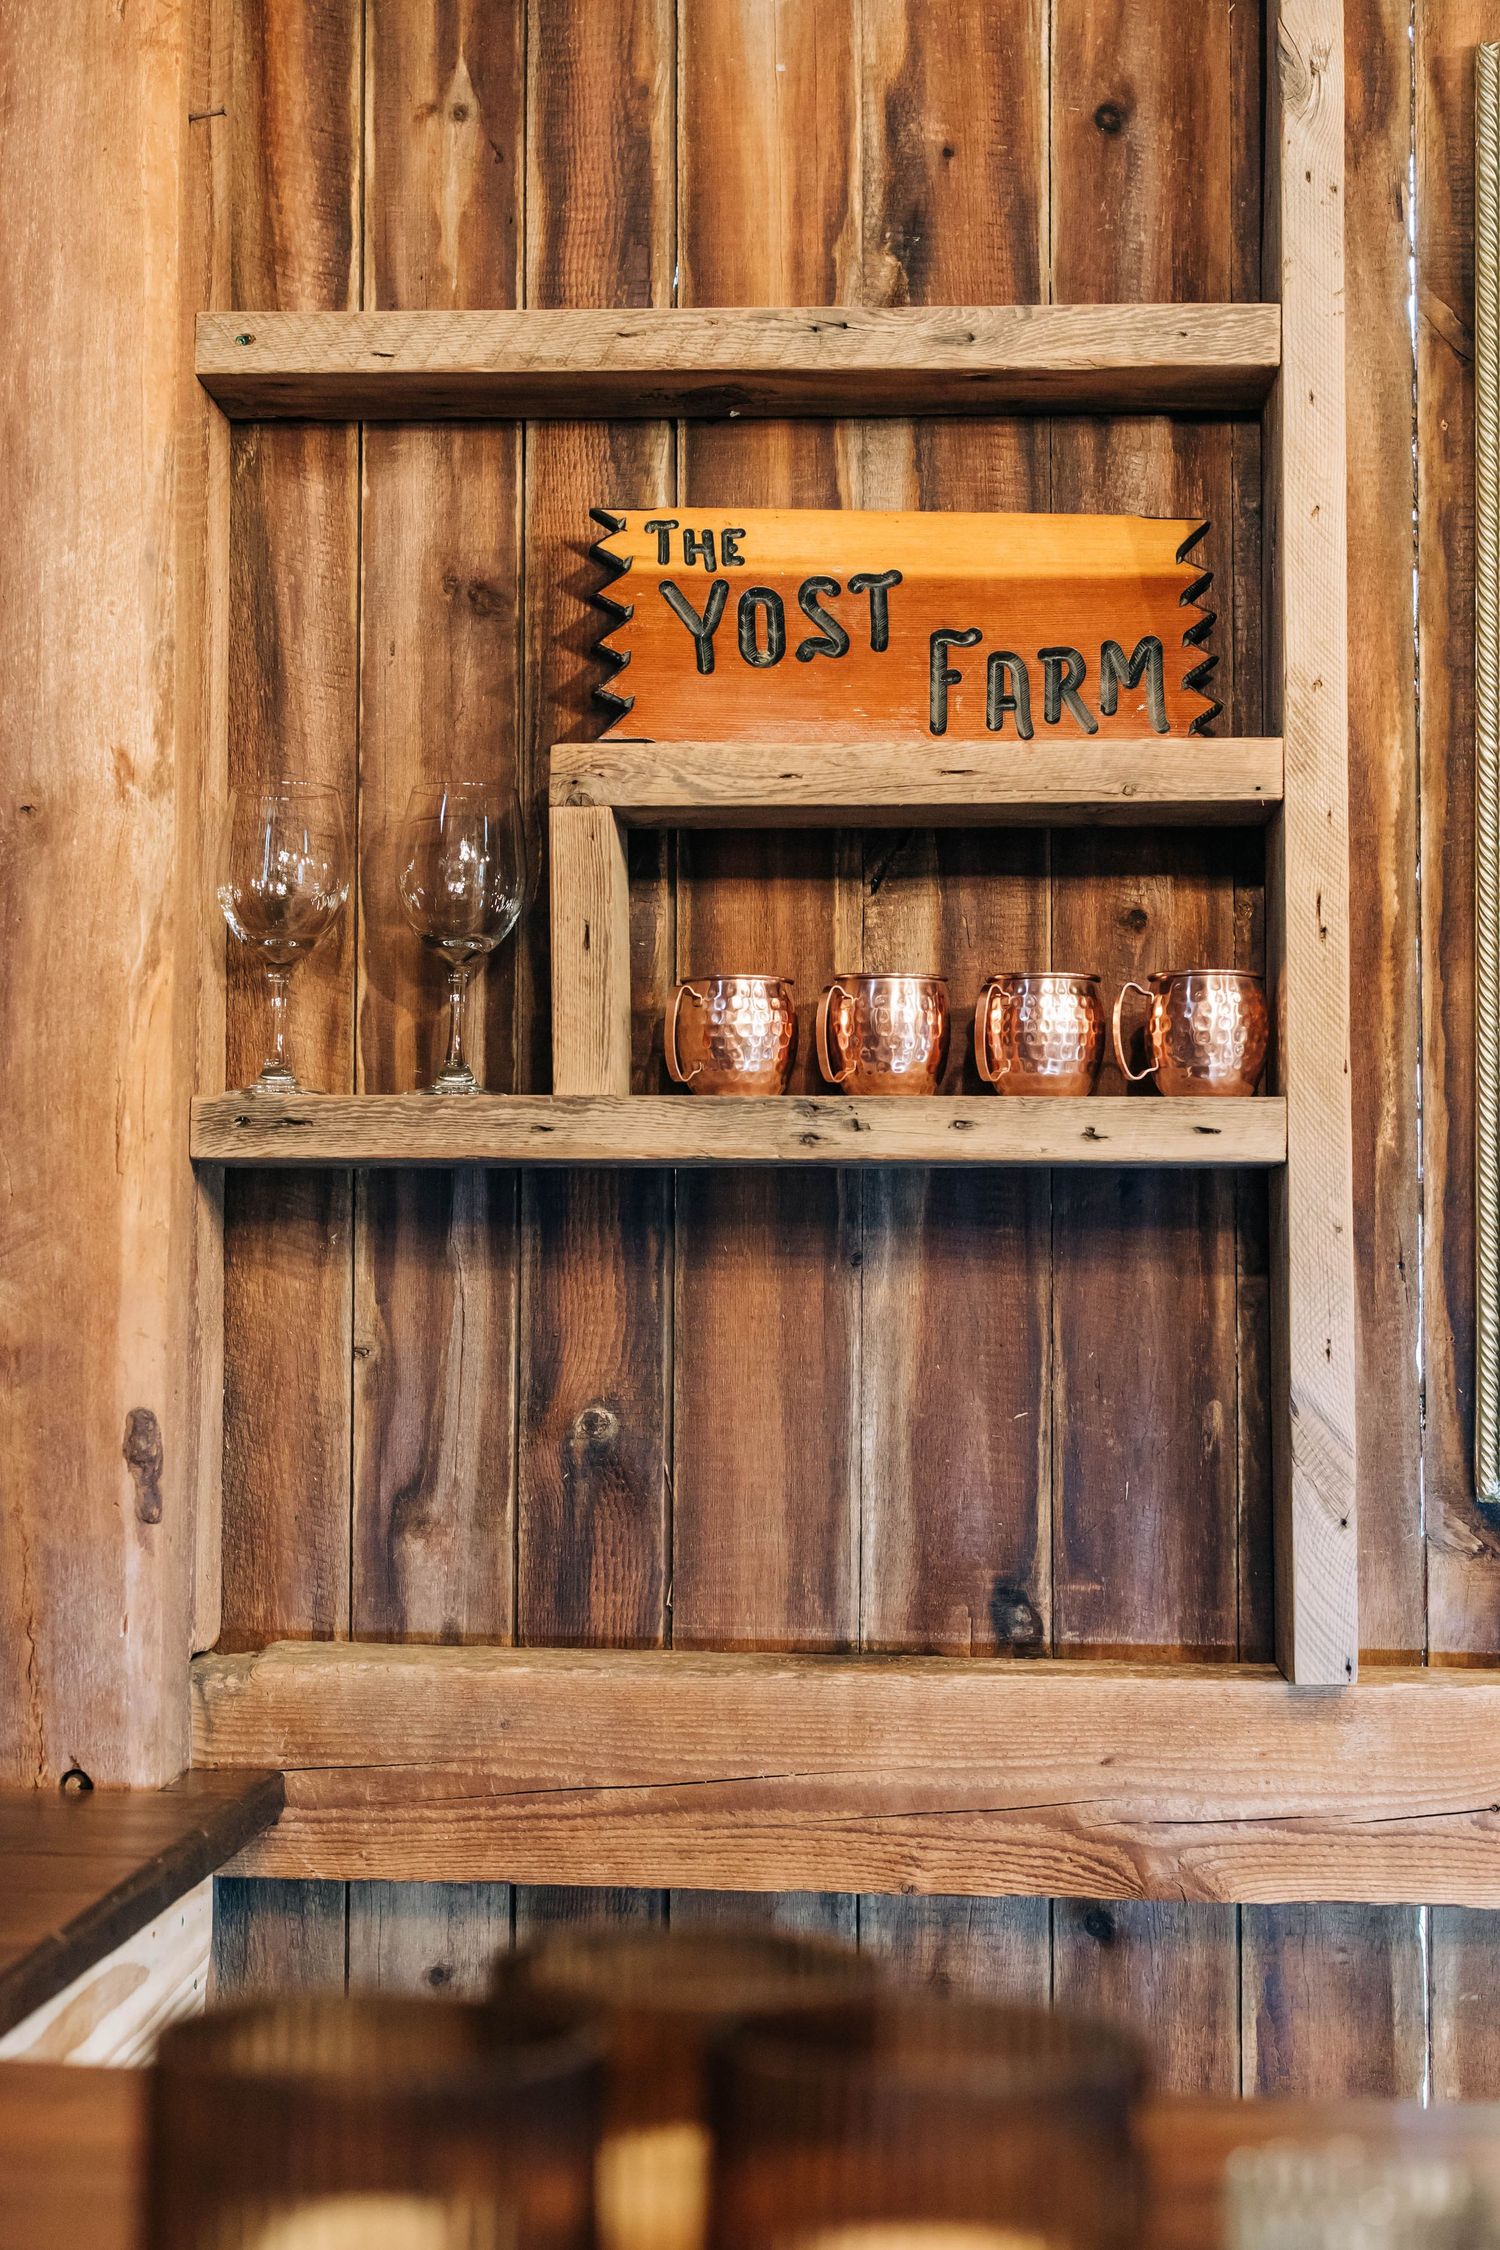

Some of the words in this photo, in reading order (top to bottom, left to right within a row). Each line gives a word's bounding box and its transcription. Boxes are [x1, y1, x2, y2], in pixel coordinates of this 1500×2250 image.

[644, 519, 747, 572] THE
[658, 569, 903, 675] YOST
[928, 627, 1170, 740] FARM
